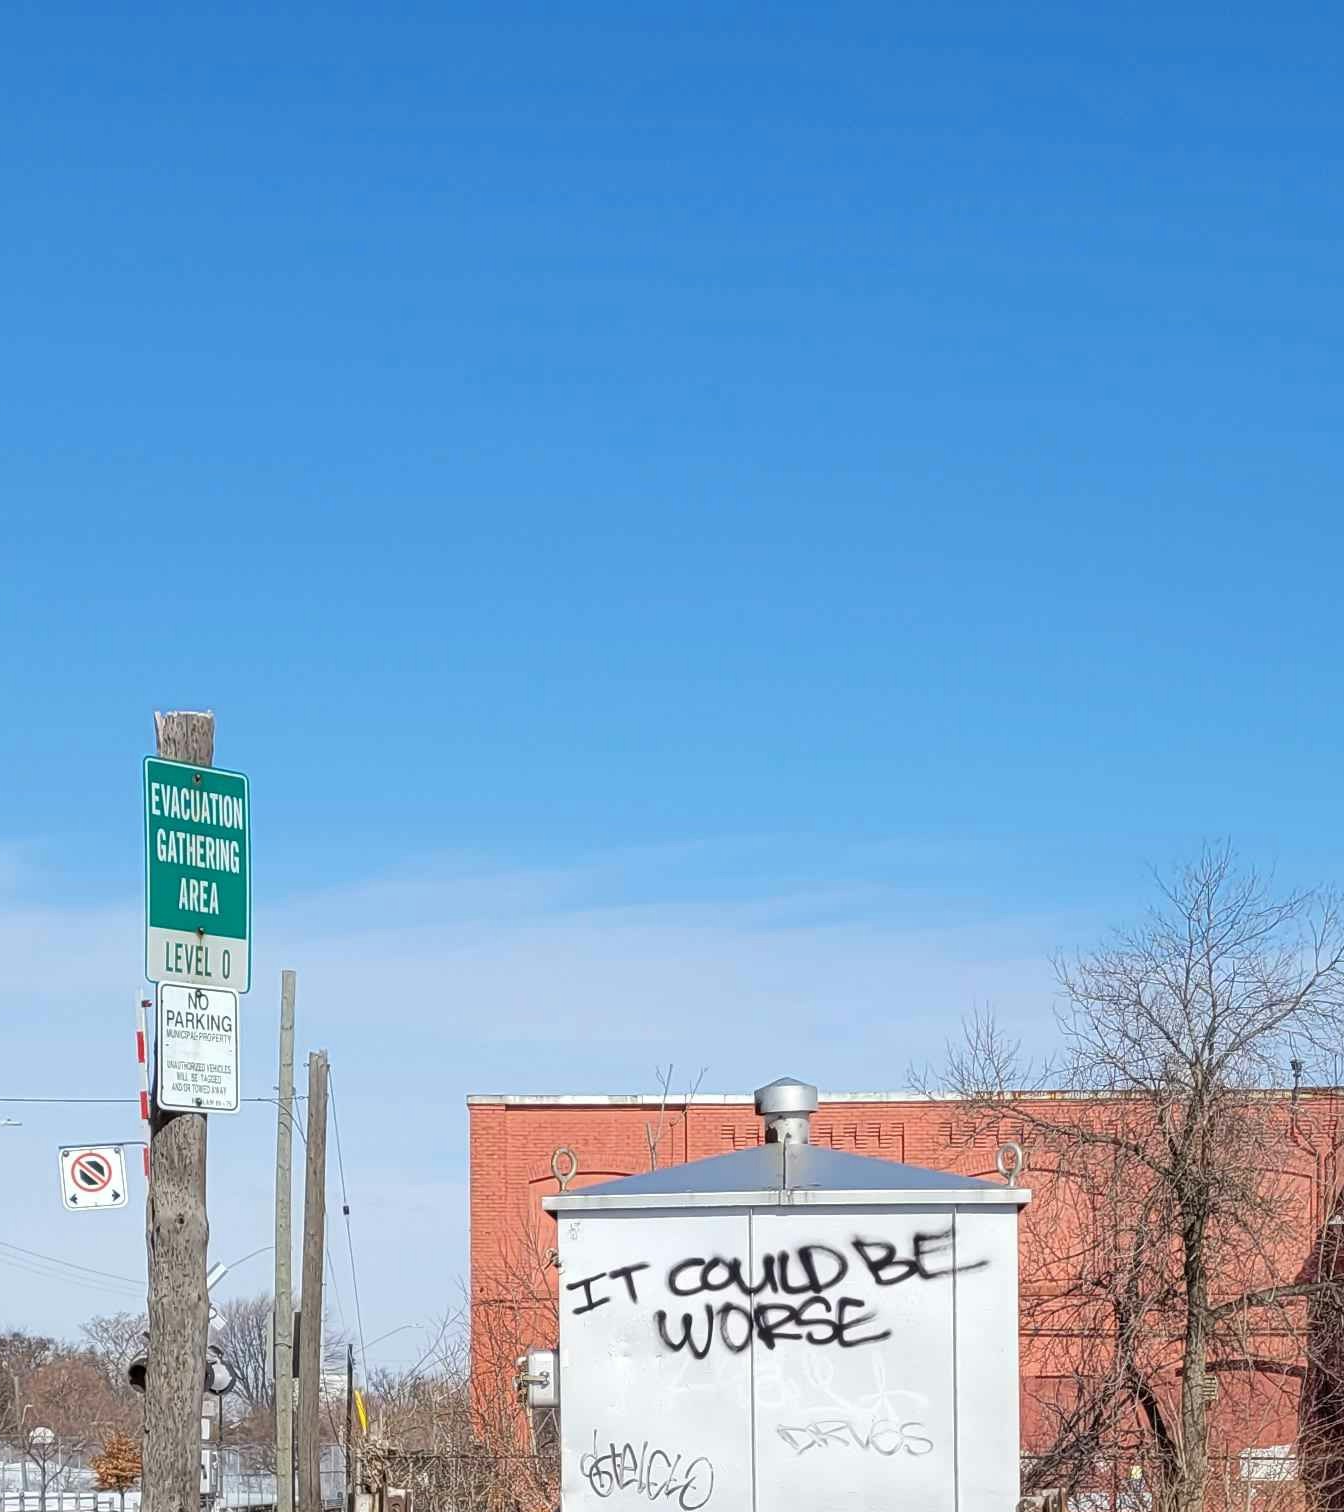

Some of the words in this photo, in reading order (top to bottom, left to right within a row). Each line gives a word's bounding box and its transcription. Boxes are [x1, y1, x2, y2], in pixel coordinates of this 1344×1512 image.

[151, 782, 243, 830] EVACUATION
[156, 828, 240, 874] GATHERING
[178, 877, 219, 915] AREA
[165, 941, 212, 977] LEVEL
[166, 1009, 232, 1033] PARKING
[188, 992, 209, 1011] NO
[566, 1262, 651, 1316] IT
[667, 1243, 849, 1297] COULD
[851, 1227, 989, 1287] BE
[655, 1295, 893, 1360] WORSE
